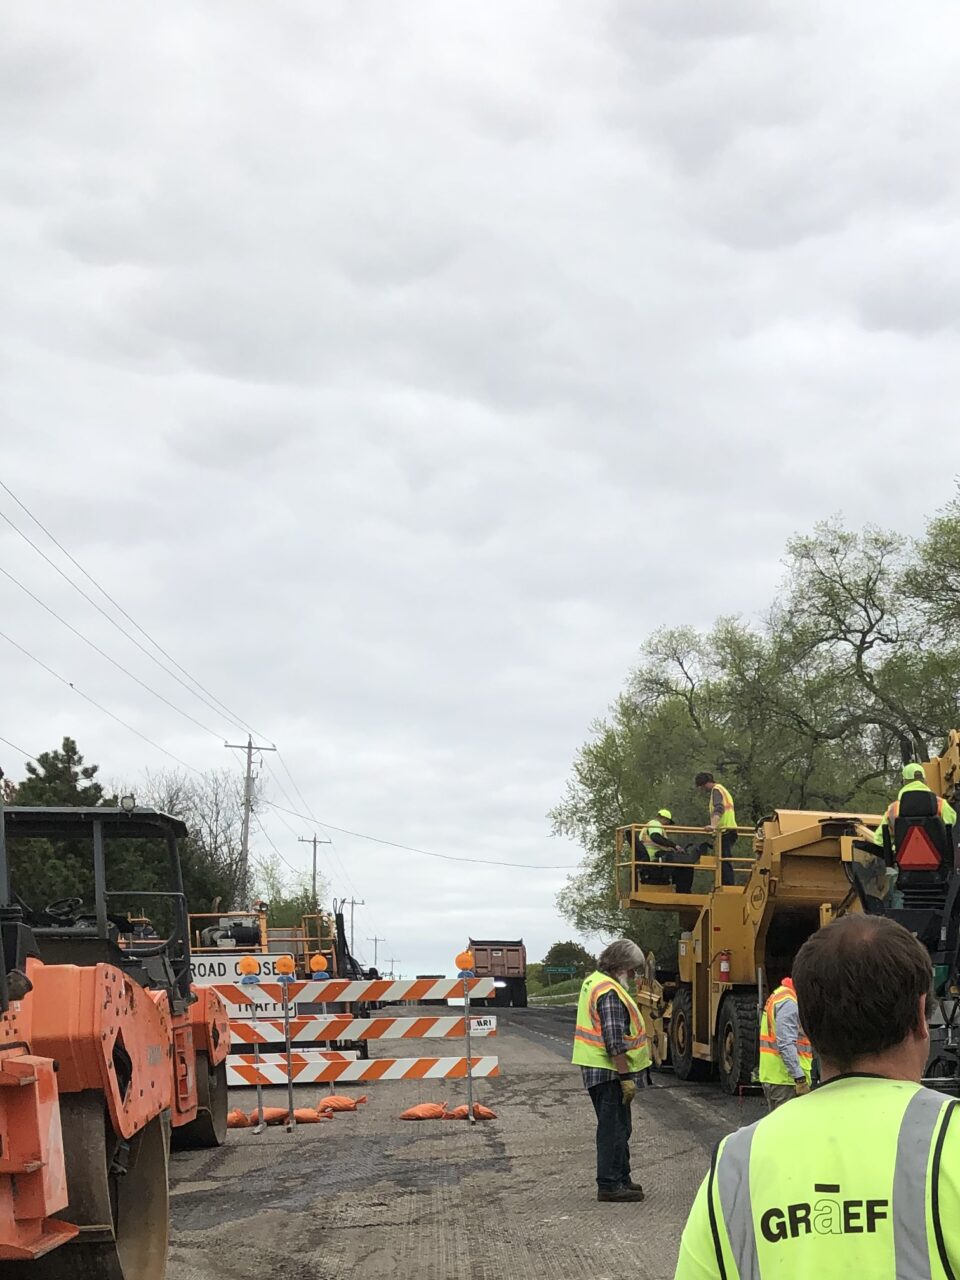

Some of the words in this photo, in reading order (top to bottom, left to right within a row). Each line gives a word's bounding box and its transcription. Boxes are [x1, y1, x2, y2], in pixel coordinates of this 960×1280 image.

[190, 962, 227, 978] ROAD
[234, 961, 282, 977] COSE
[237, 1002, 294, 1013] TRAFFI
